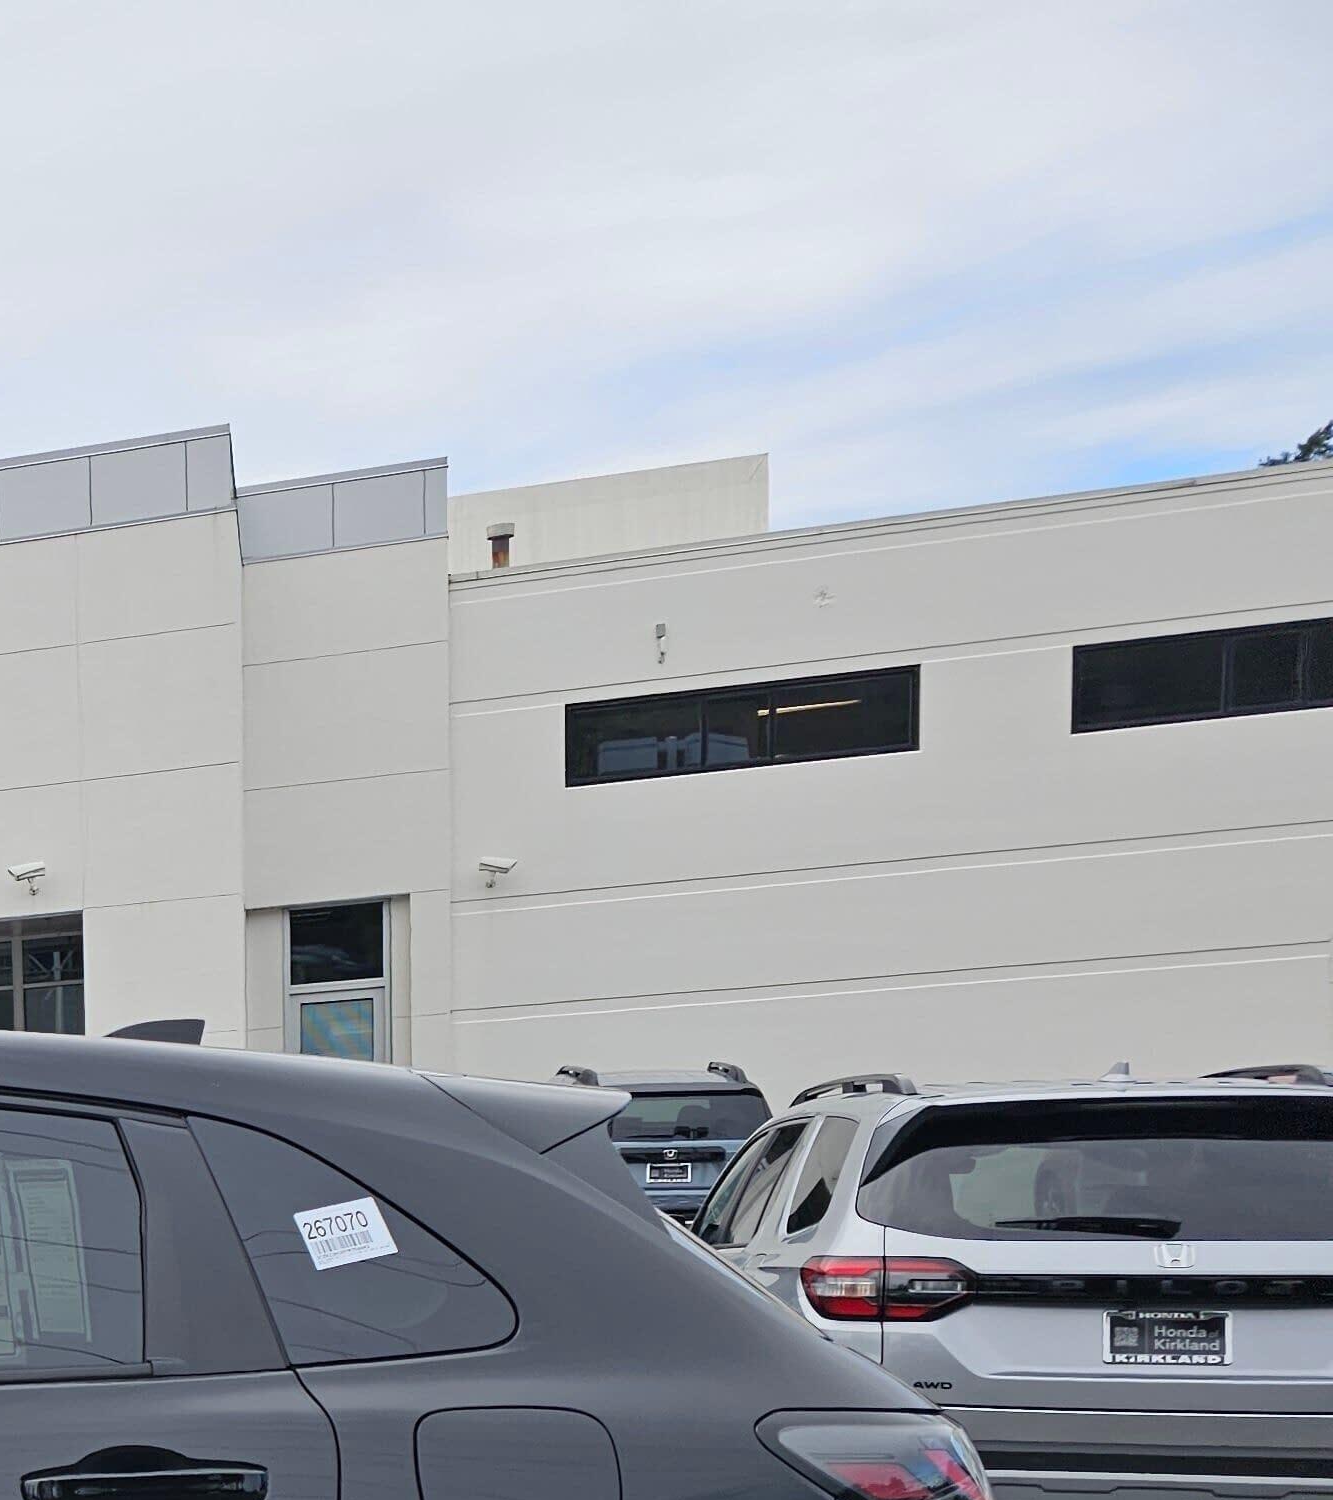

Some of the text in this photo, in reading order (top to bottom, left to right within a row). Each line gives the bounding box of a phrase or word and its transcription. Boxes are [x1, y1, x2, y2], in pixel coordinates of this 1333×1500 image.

[303, 1211, 368, 1240] 267070
[1051, 1280, 1305, 1296] PILOT
[1154, 1326, 1207, 1337] Honda
[1154, 1338, 1220, 1350] Kirkland
[1115, 1354, 1222, 1364] KIRKLAND
[913, 1381, 952, 1390] AWD
